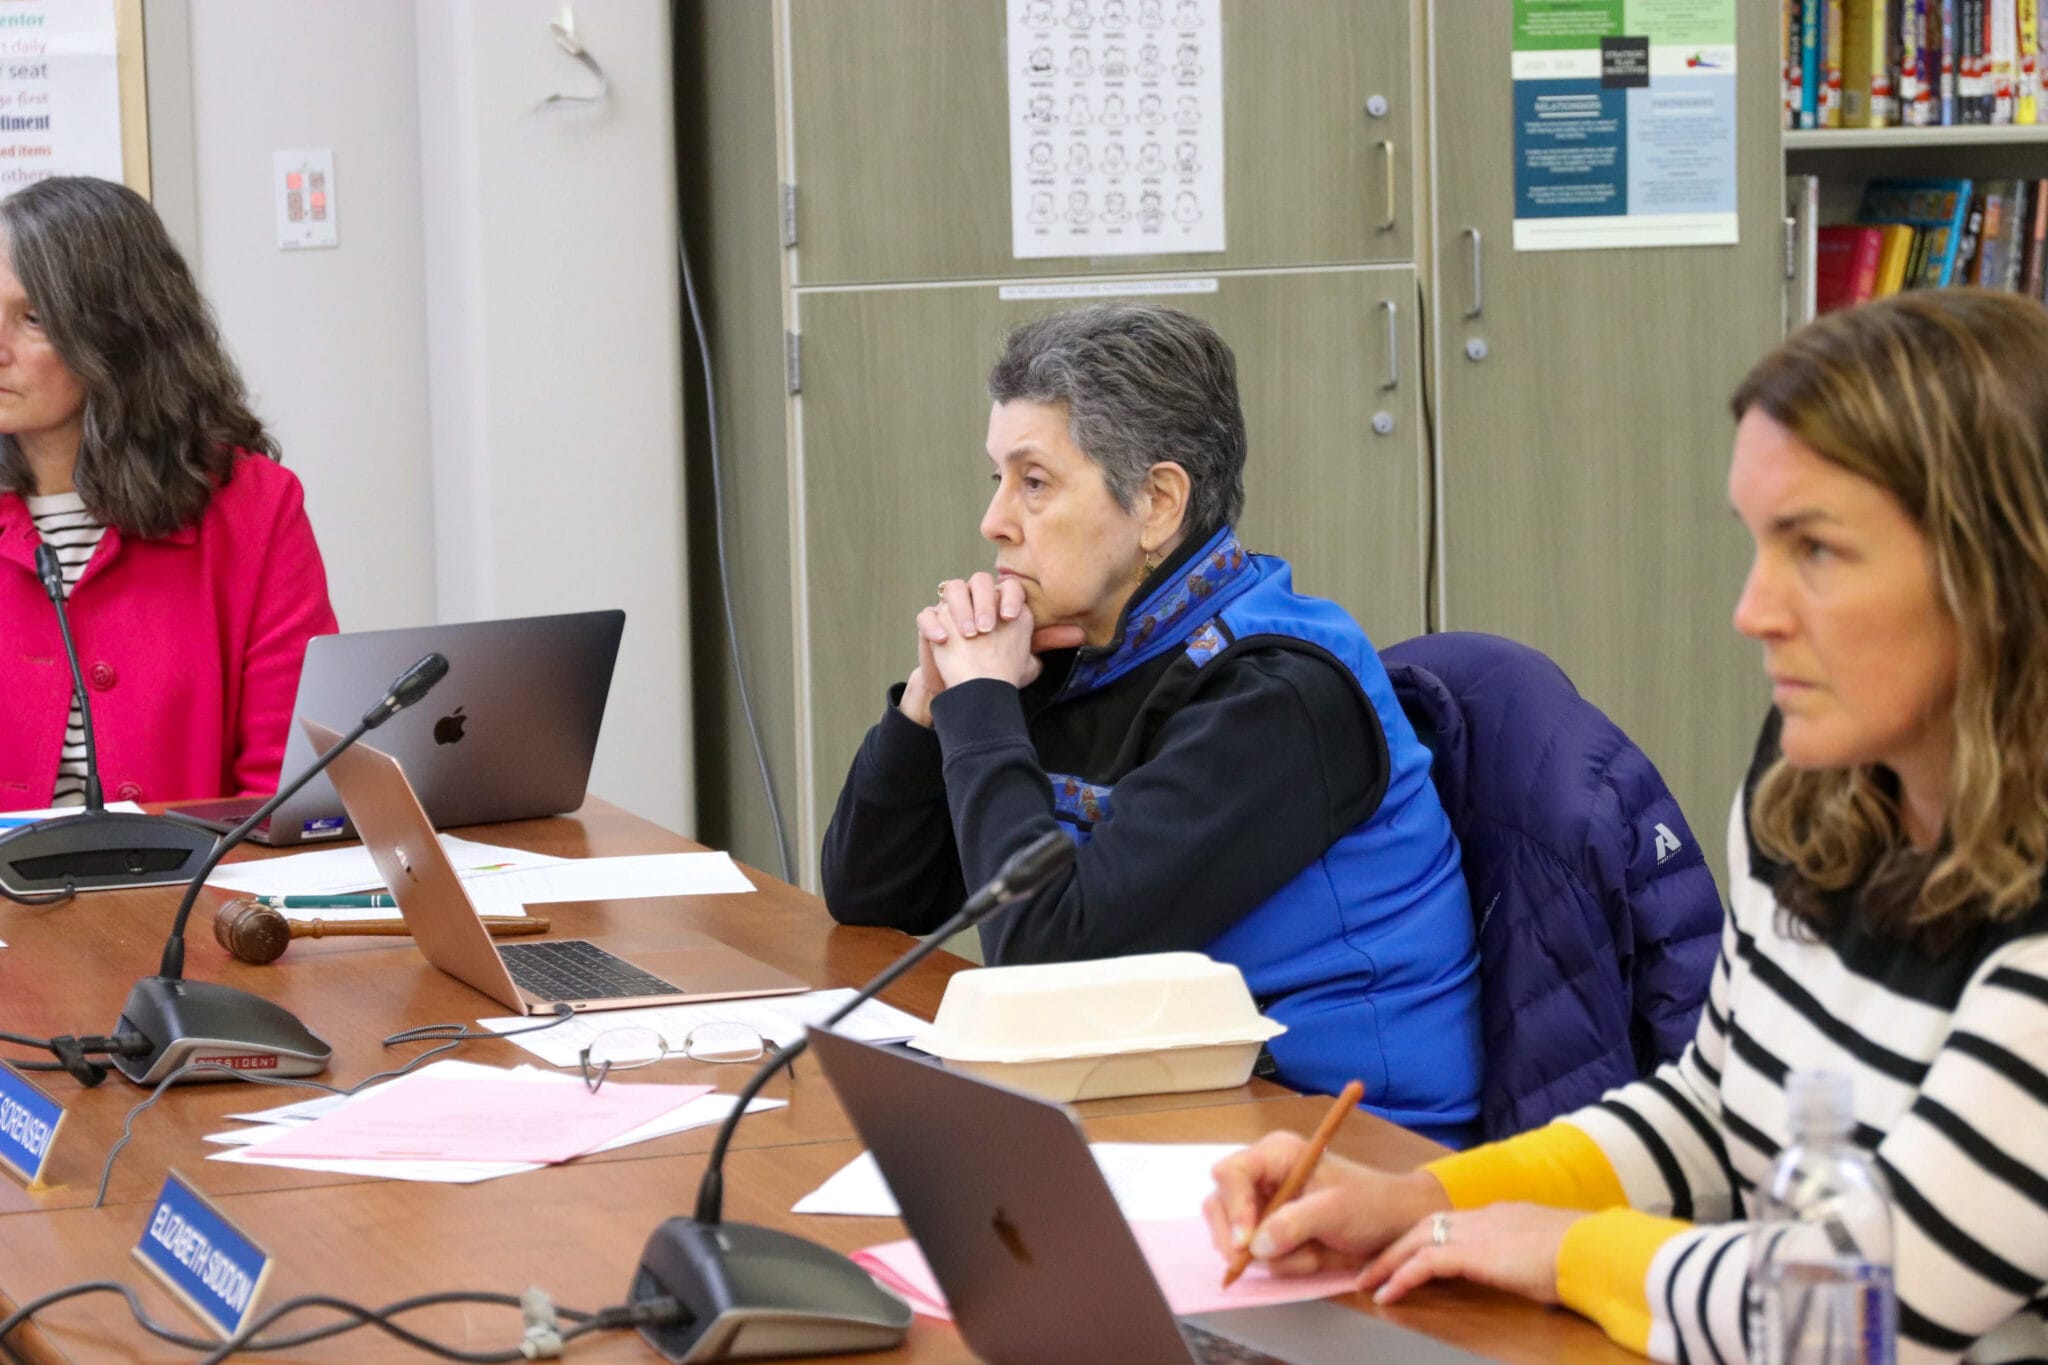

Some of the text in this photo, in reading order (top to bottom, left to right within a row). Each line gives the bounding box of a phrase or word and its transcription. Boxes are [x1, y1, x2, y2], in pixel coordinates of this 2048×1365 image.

[11, 39, 47, 56] daily
[8, 64, 49, 80] seat
[1, 1097, 52, 1159] SORENSEN
[150, 1203, 212, 1277] ELIZABETH
